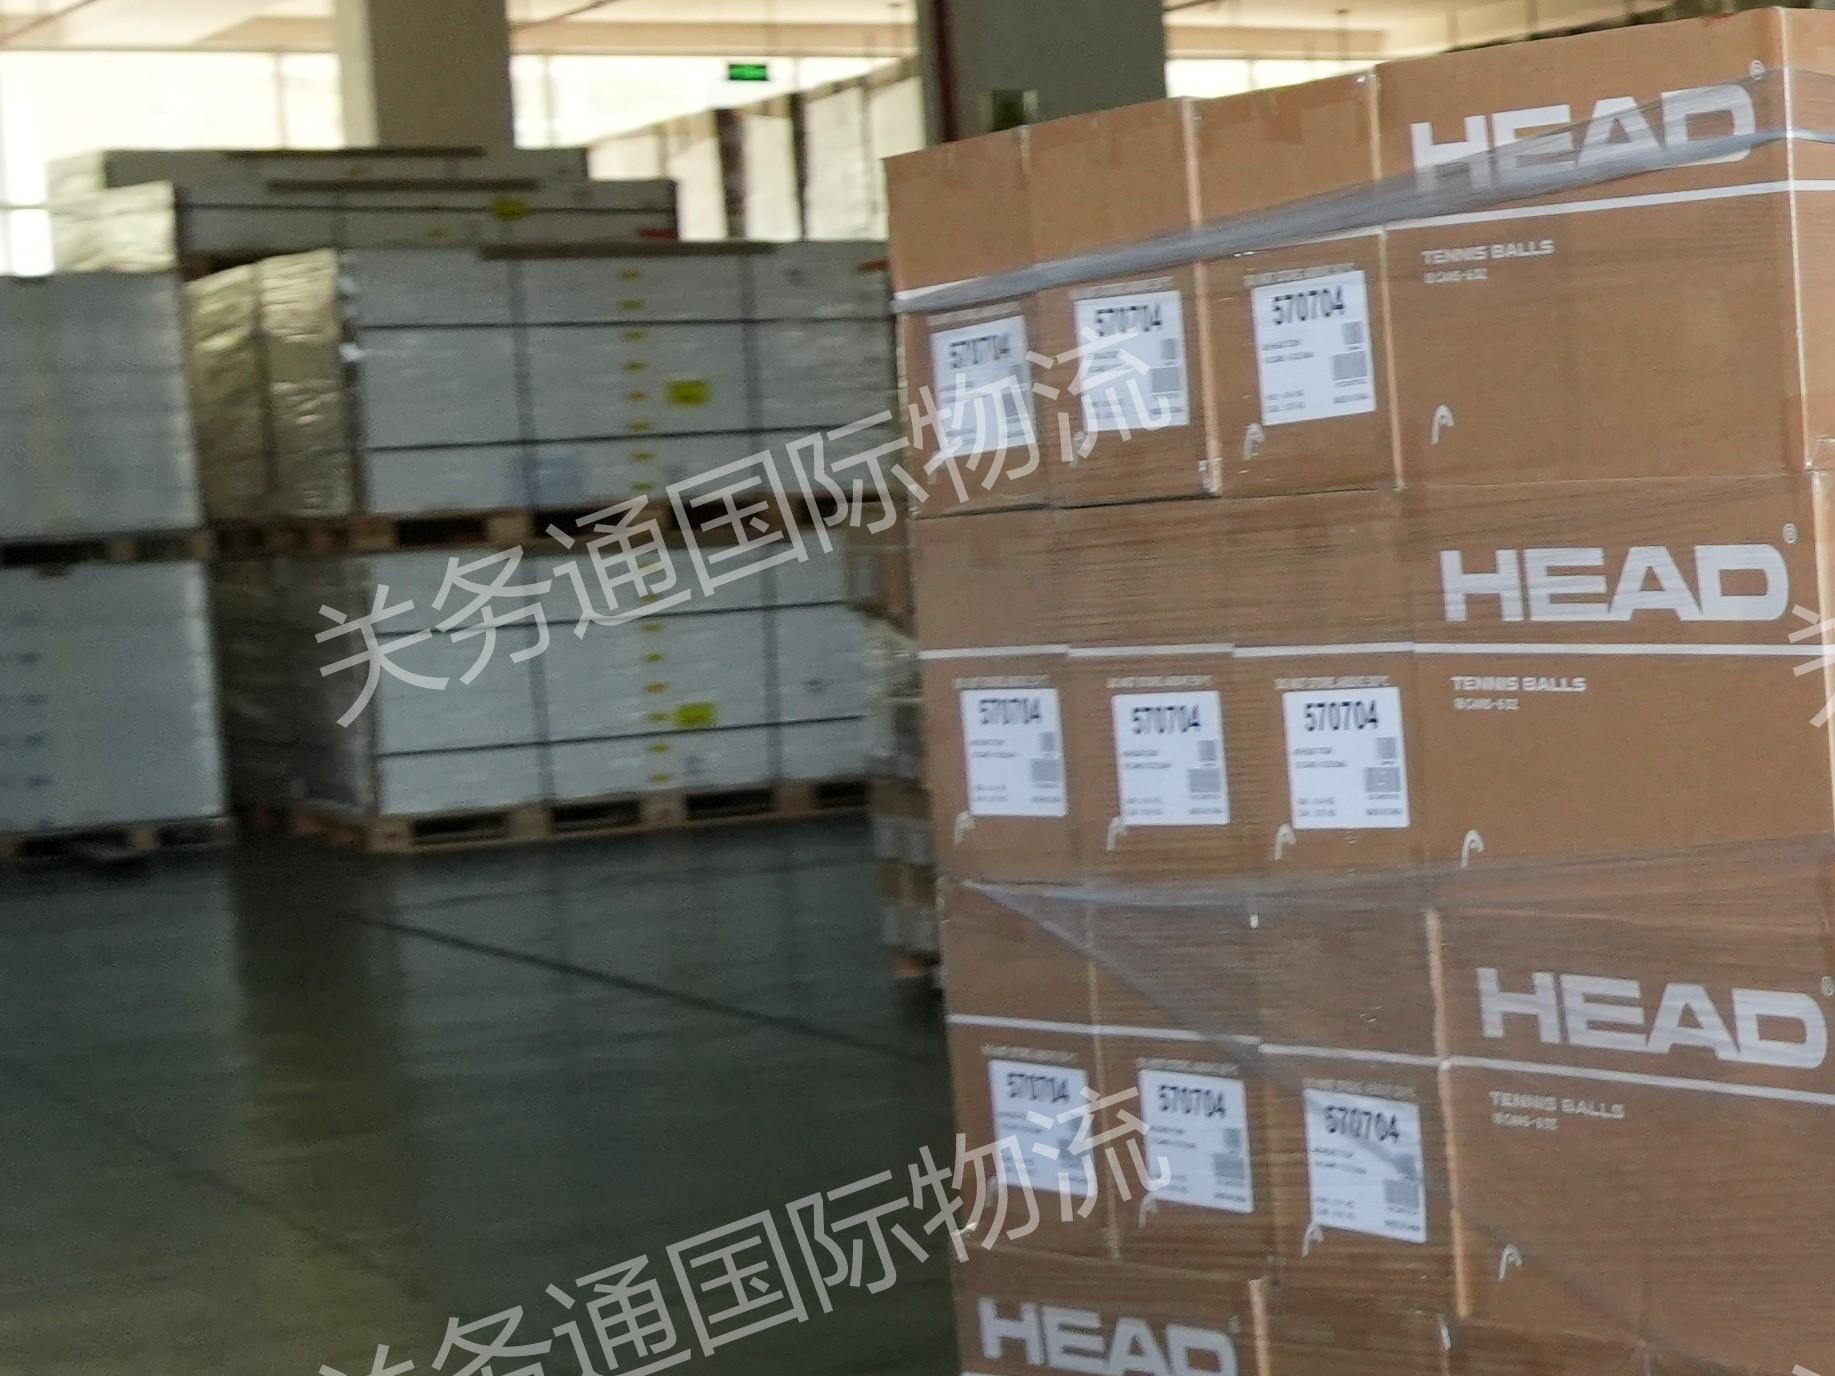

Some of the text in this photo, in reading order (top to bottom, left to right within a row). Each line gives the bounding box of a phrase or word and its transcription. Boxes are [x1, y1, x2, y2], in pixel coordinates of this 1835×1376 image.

[1411, 83, 1757, 192] HEAD
[1272, 285, 1345, 325] 570704
[1441, 544, 1790, 622] HEAD
[1522, 677, 1586, 692] BALLS
[1304, 701, 1379, 732] 570704
[1476, 967, 1829, 1069] HEAD
[1325, 1104, 1401, 1144] 570704
